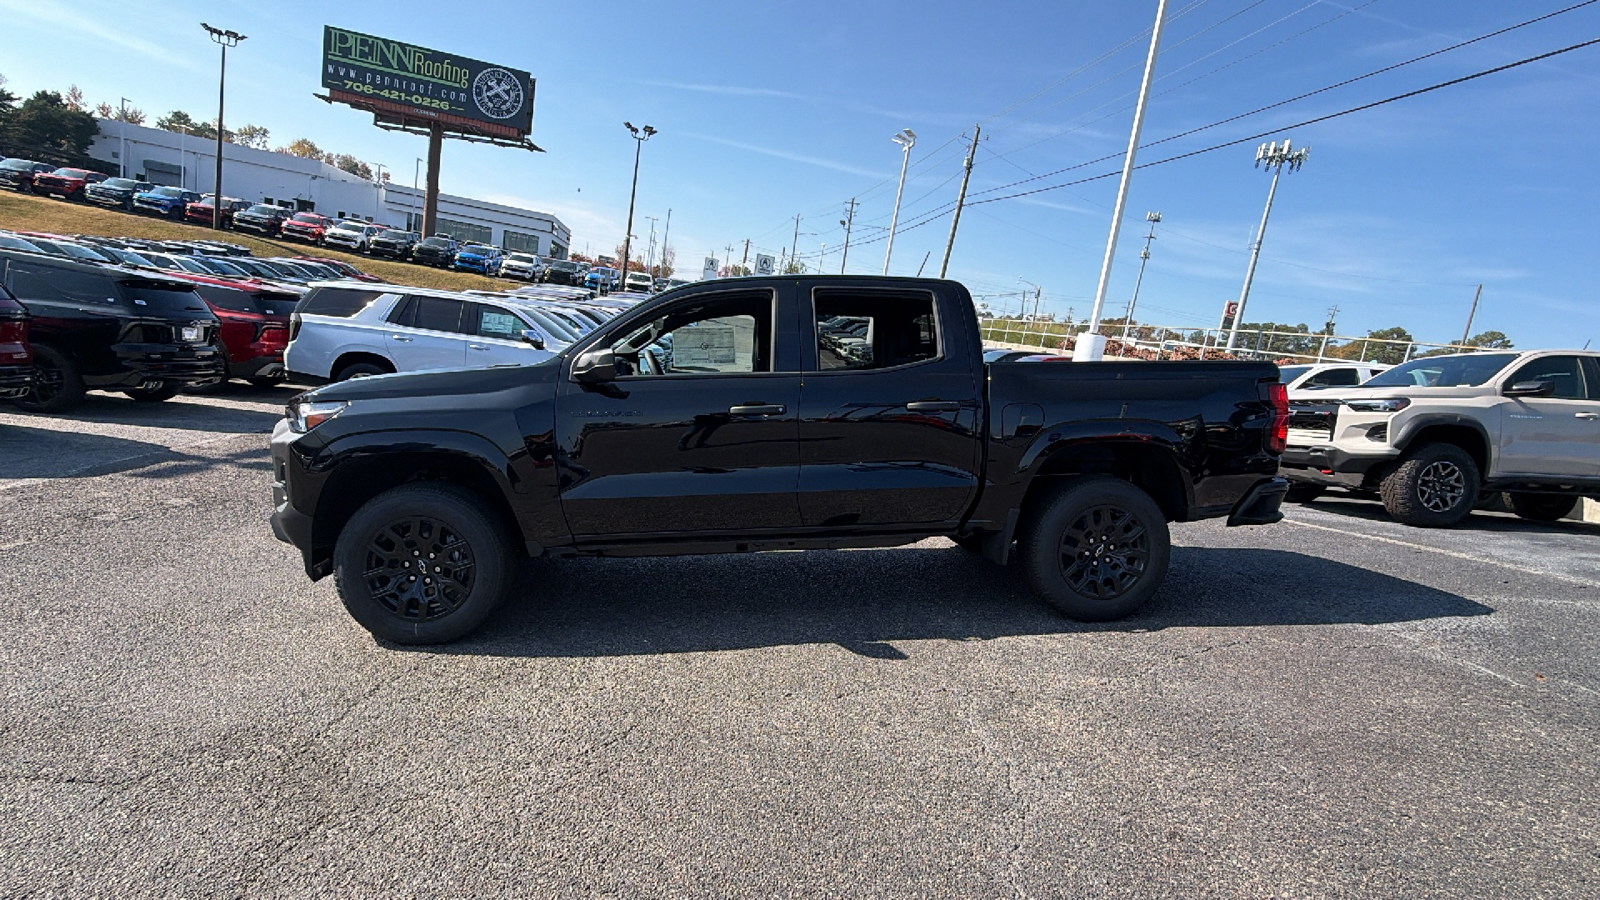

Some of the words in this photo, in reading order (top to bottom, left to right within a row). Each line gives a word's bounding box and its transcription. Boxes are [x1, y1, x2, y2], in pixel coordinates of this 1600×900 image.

[328, 28, 432, 72] PENN
[414, 52, 469, 89] Roofing
[327, 64, 467, 103] www.pennroof.com
[343, 79, 450, 111] 706-421-0226
